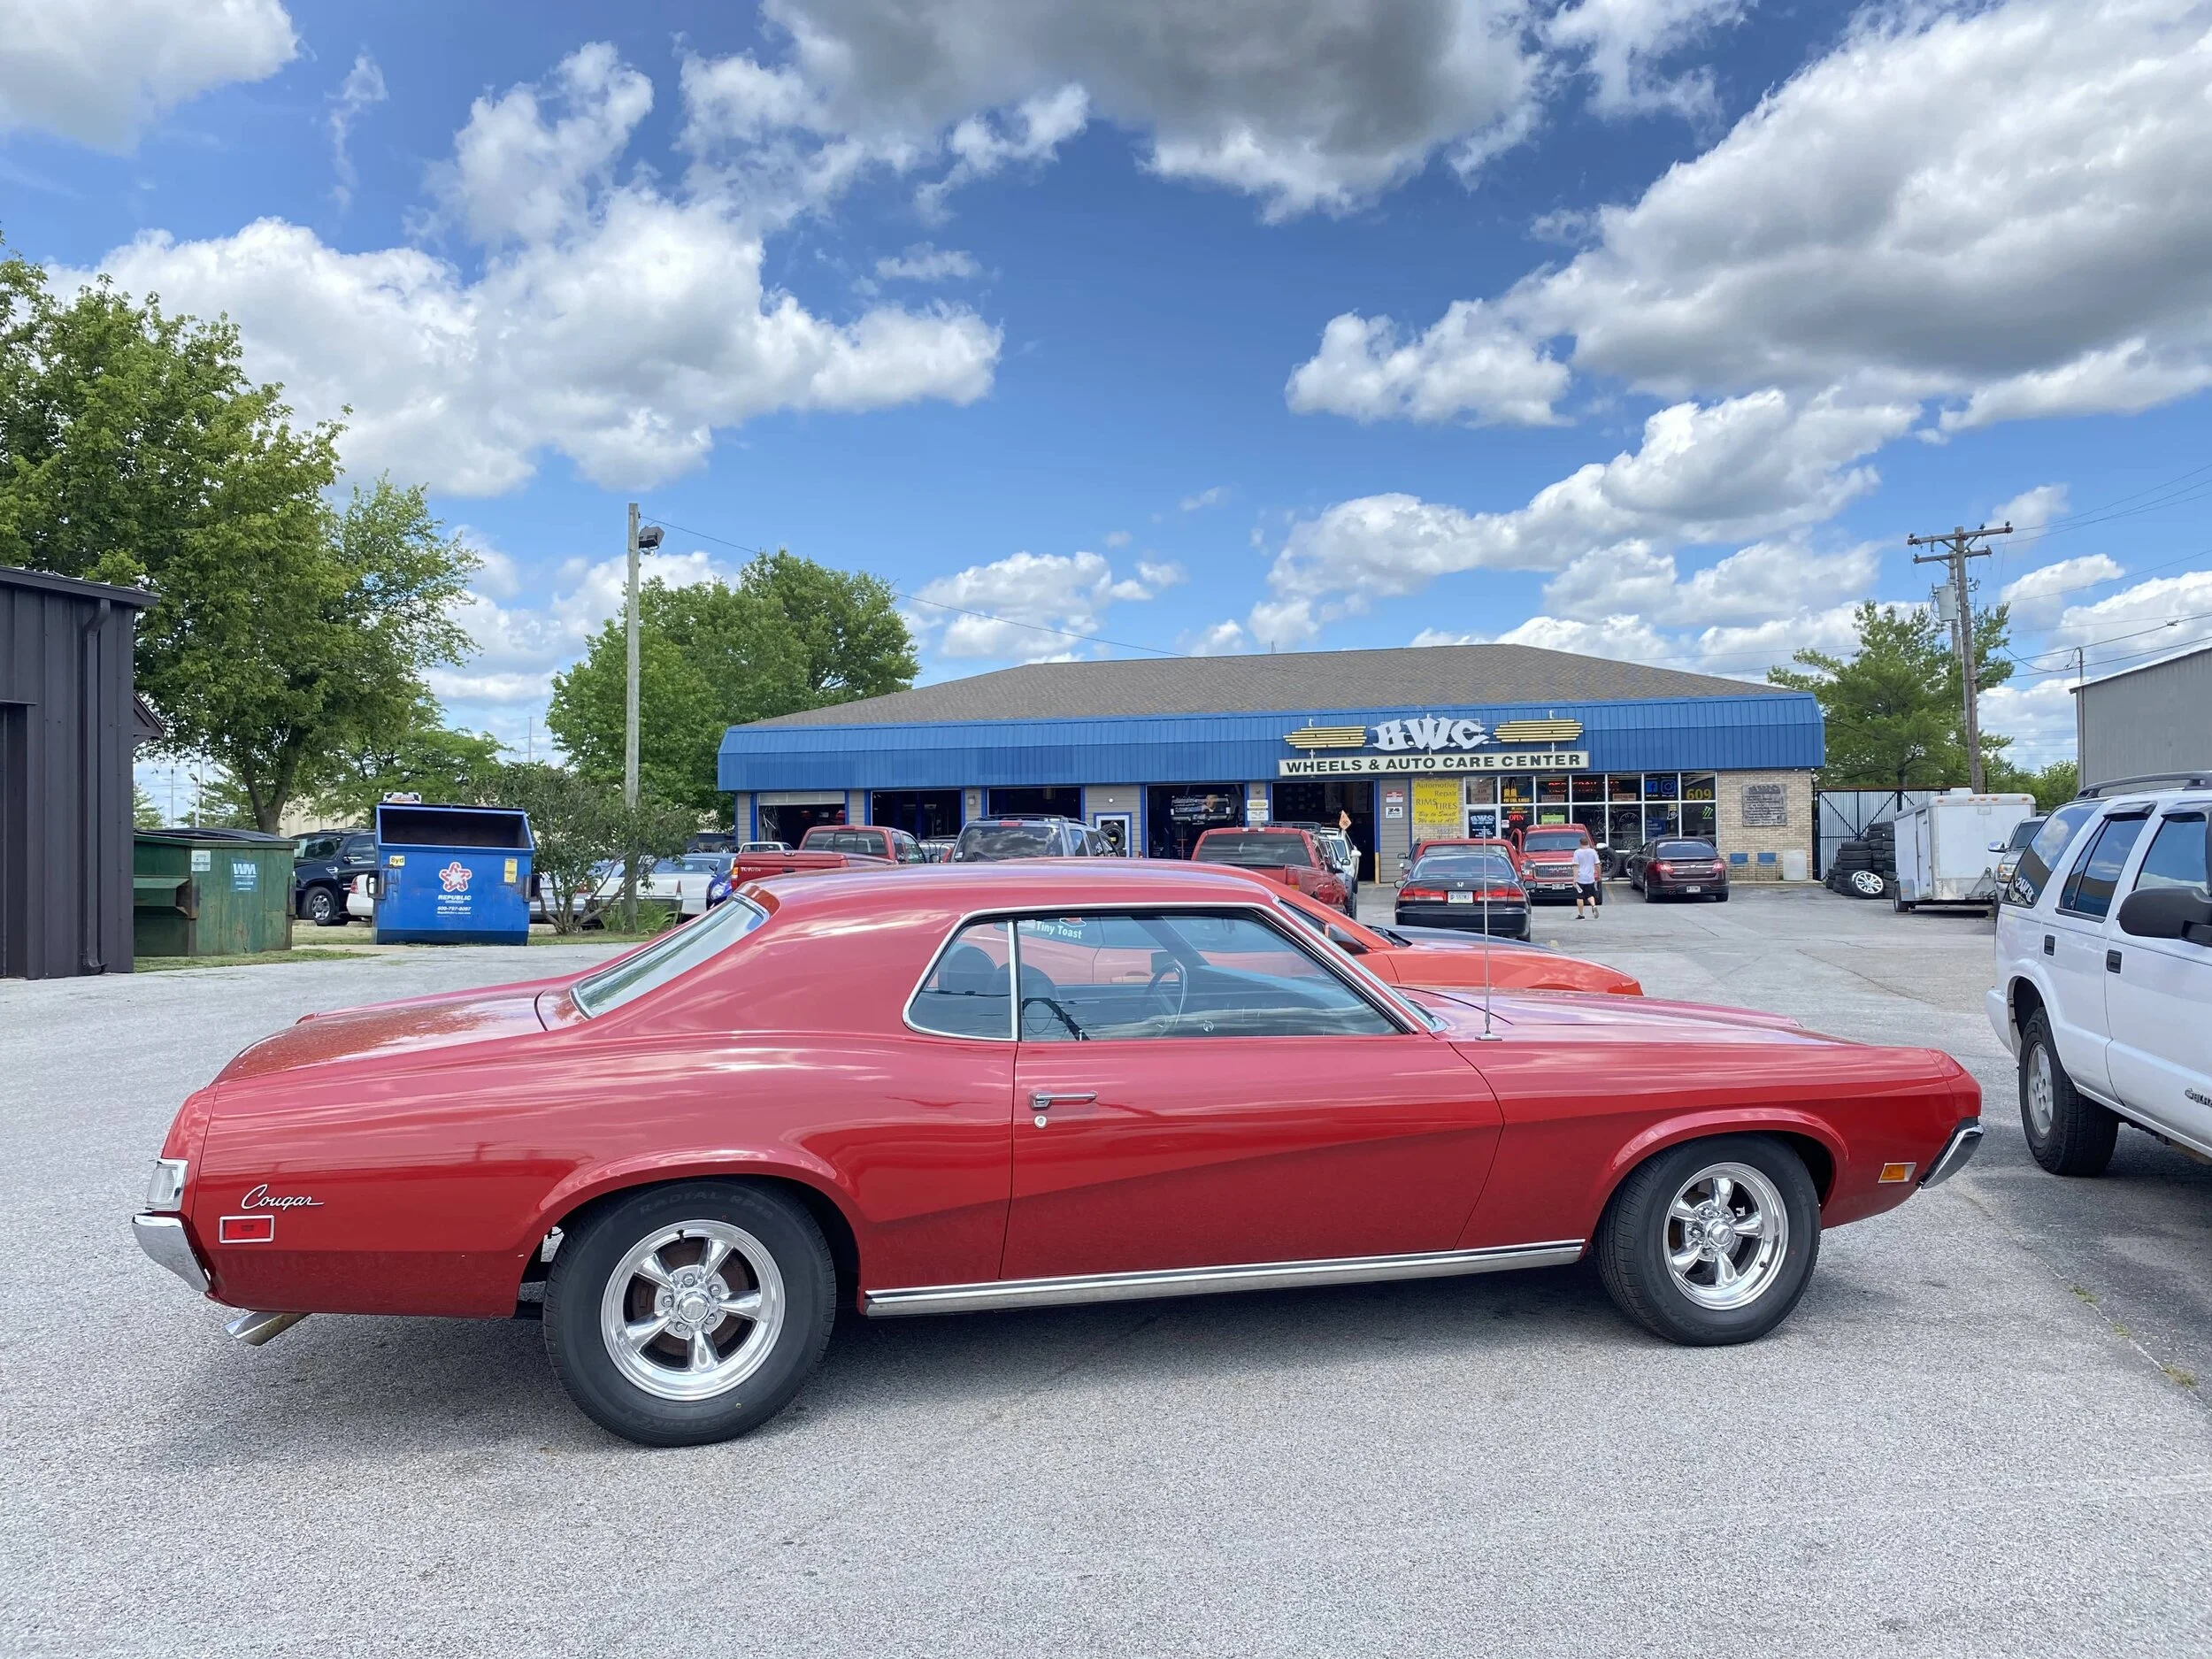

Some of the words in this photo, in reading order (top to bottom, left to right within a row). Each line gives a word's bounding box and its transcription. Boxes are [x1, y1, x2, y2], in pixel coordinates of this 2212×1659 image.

[1286, 759, 1363, 773] WHEELS
[1369, 758, 1380, 771] &
[1386, 757, 1436, 770] AUTO
[1443, 755, 1494, 768] CARE
[1502, 754, 1581, 767] CENTER
[1686, 788, 1712, 800] 609
[233, 863, 257, 875] WM
[1036, 920, 1056, 935] Tiny
[1057, 925, 1082, 940] Toast
[241, 1184, 325, 1211] Cougar
